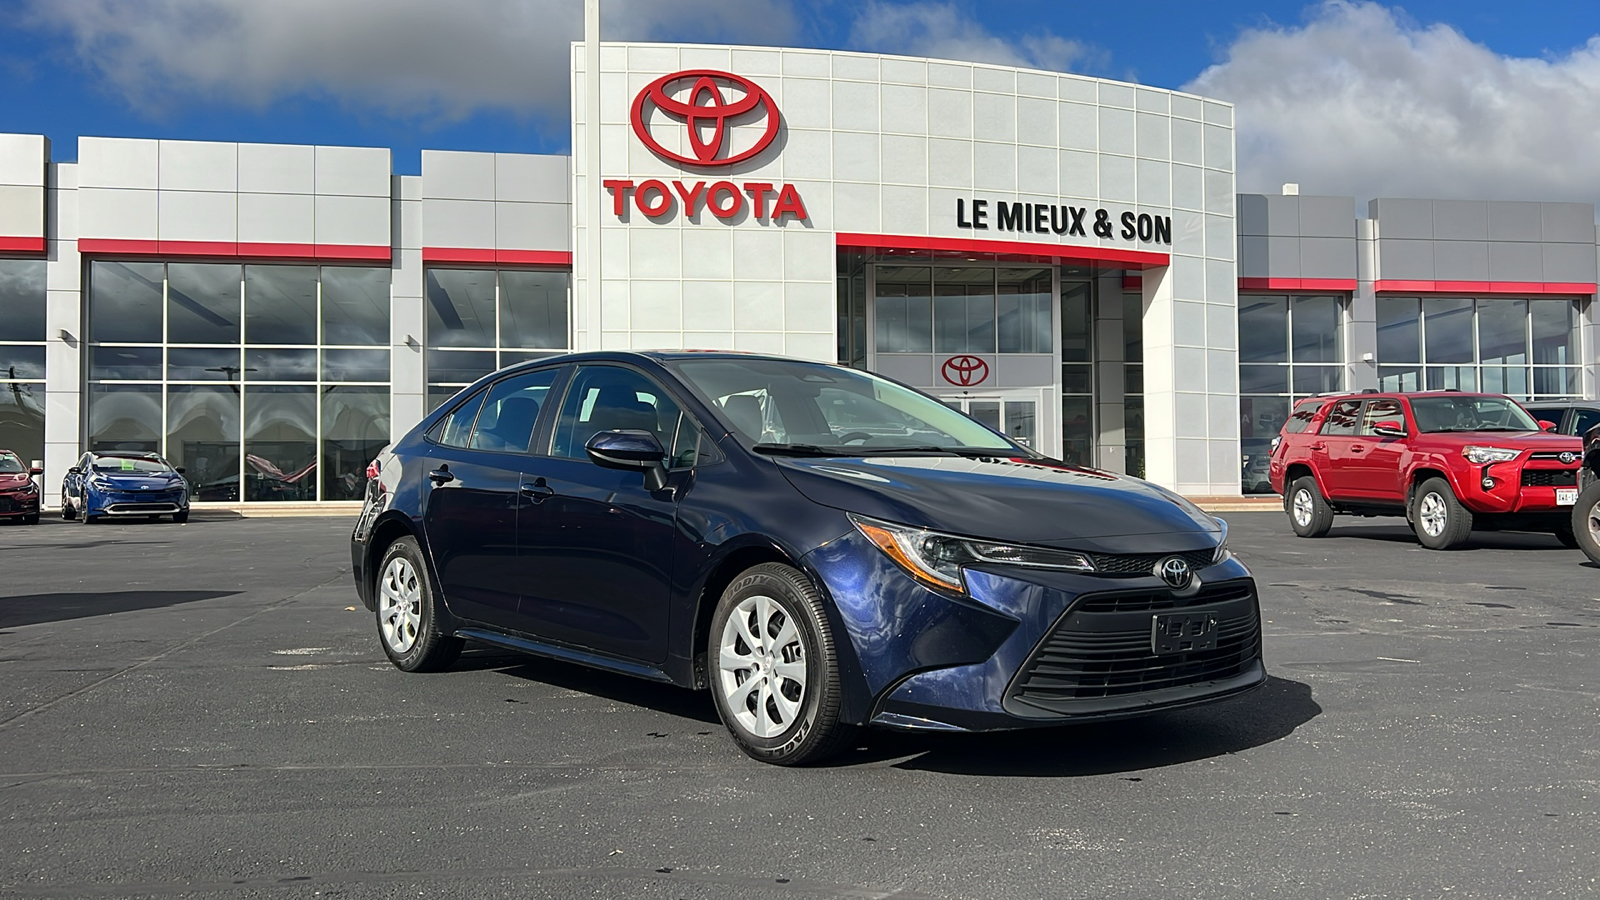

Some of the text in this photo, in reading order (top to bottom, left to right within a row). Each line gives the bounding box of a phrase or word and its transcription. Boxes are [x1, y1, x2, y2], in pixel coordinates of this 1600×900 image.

[603, 179, 808, 219] TOYOTA
[957, 198, 1171, 244] LE MIEUX & SON
